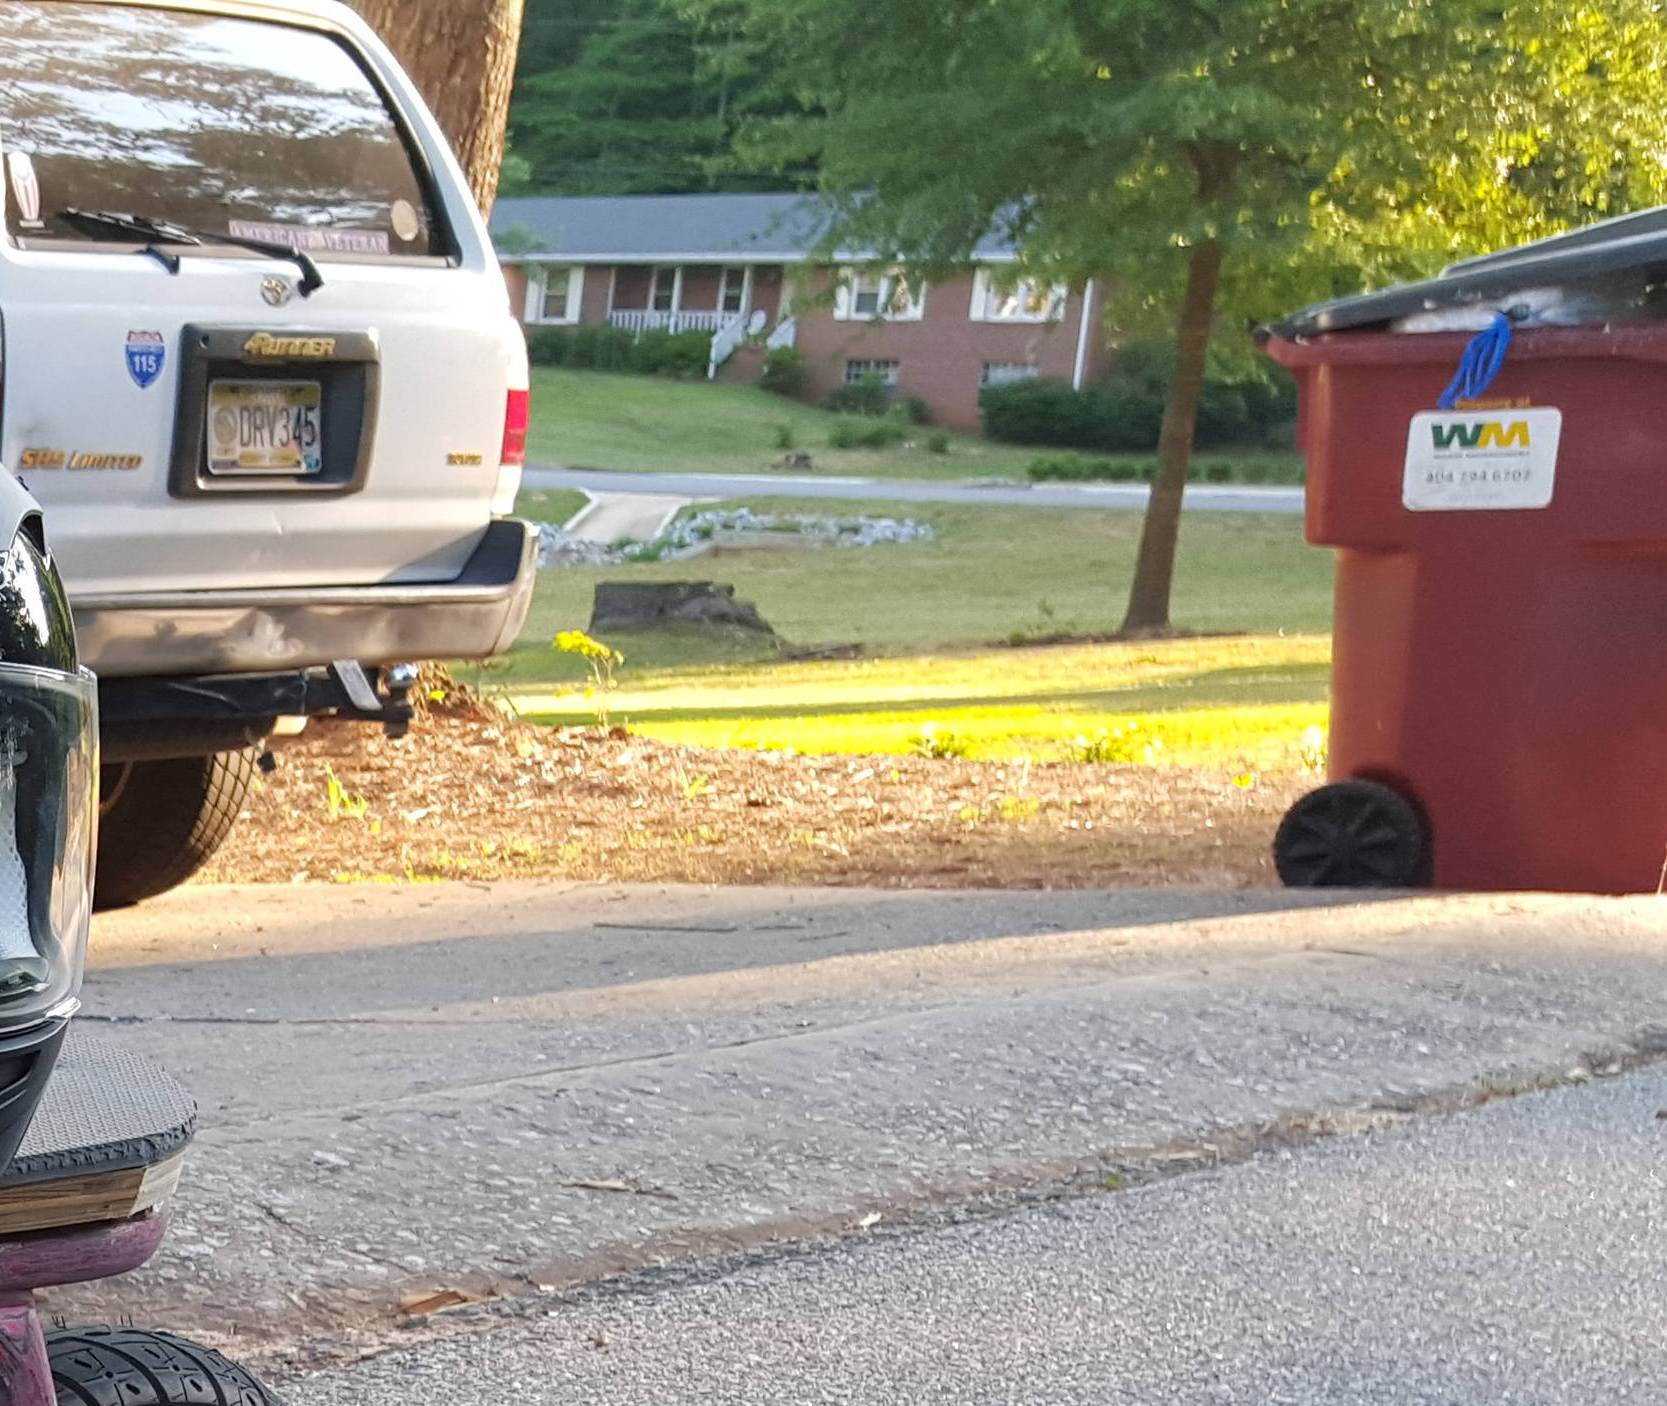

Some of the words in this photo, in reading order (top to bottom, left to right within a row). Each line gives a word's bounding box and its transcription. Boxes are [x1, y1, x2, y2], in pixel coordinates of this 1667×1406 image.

[133, 354, 157, 374] 115
[239, 406, 317, 448] DRV345
[1430, 421, 1531, 449] WM
